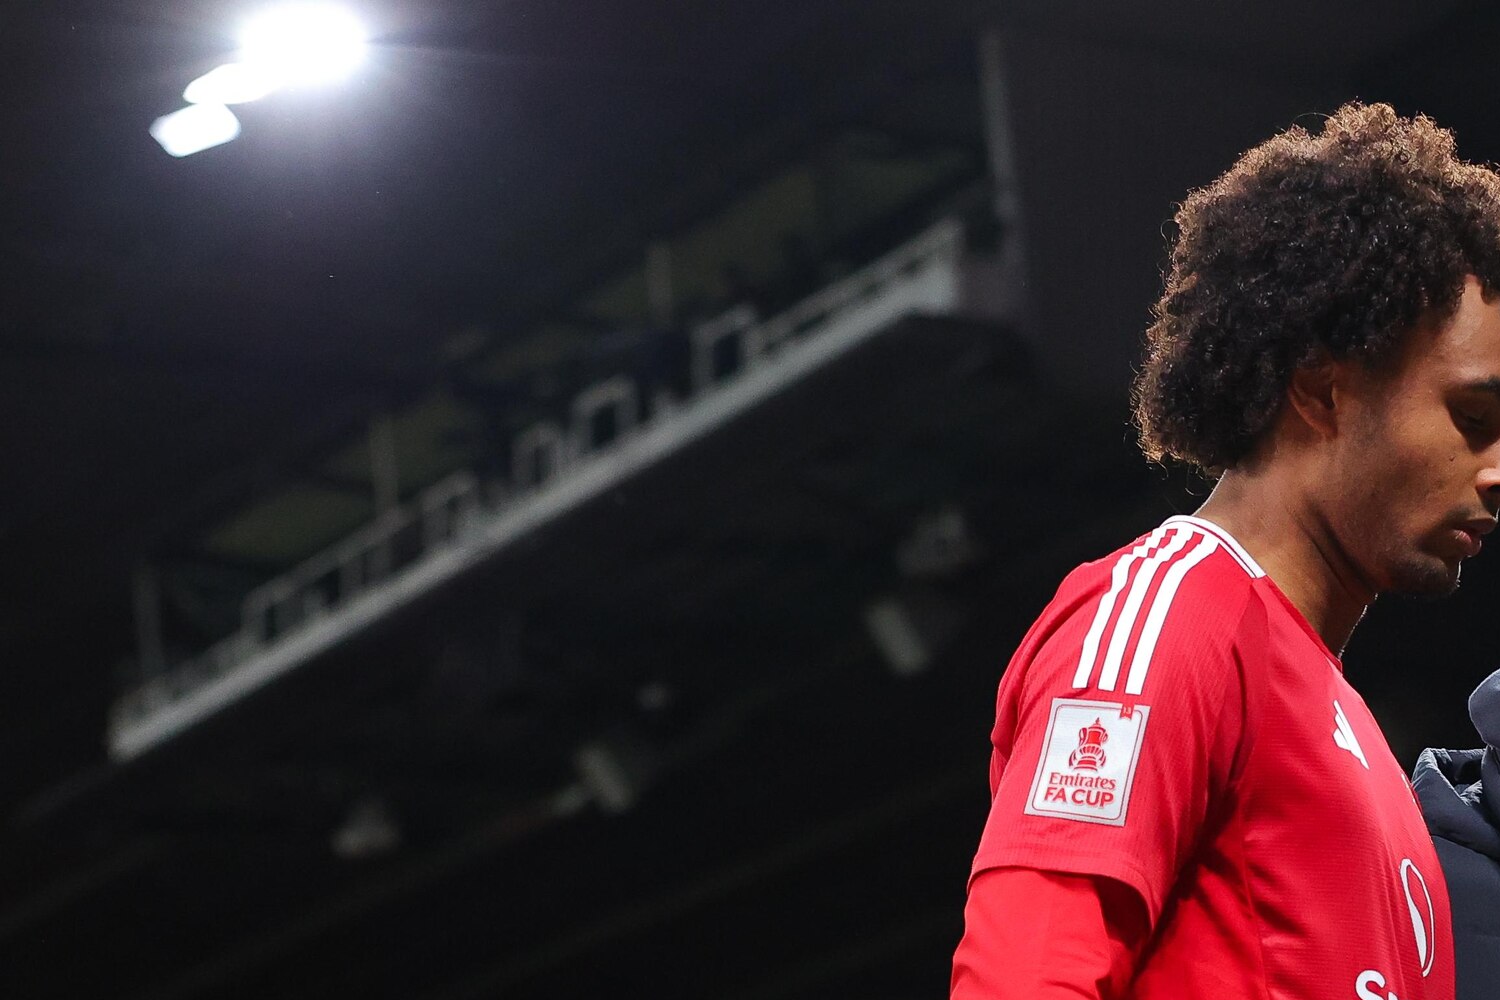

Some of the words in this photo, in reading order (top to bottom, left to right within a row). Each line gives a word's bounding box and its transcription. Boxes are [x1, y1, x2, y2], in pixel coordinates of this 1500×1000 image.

[1049, 772, 1116, 790] Emirates
[1044, 786, 1067, 803] FA
[1071, 788, 1114, 808] CUP
